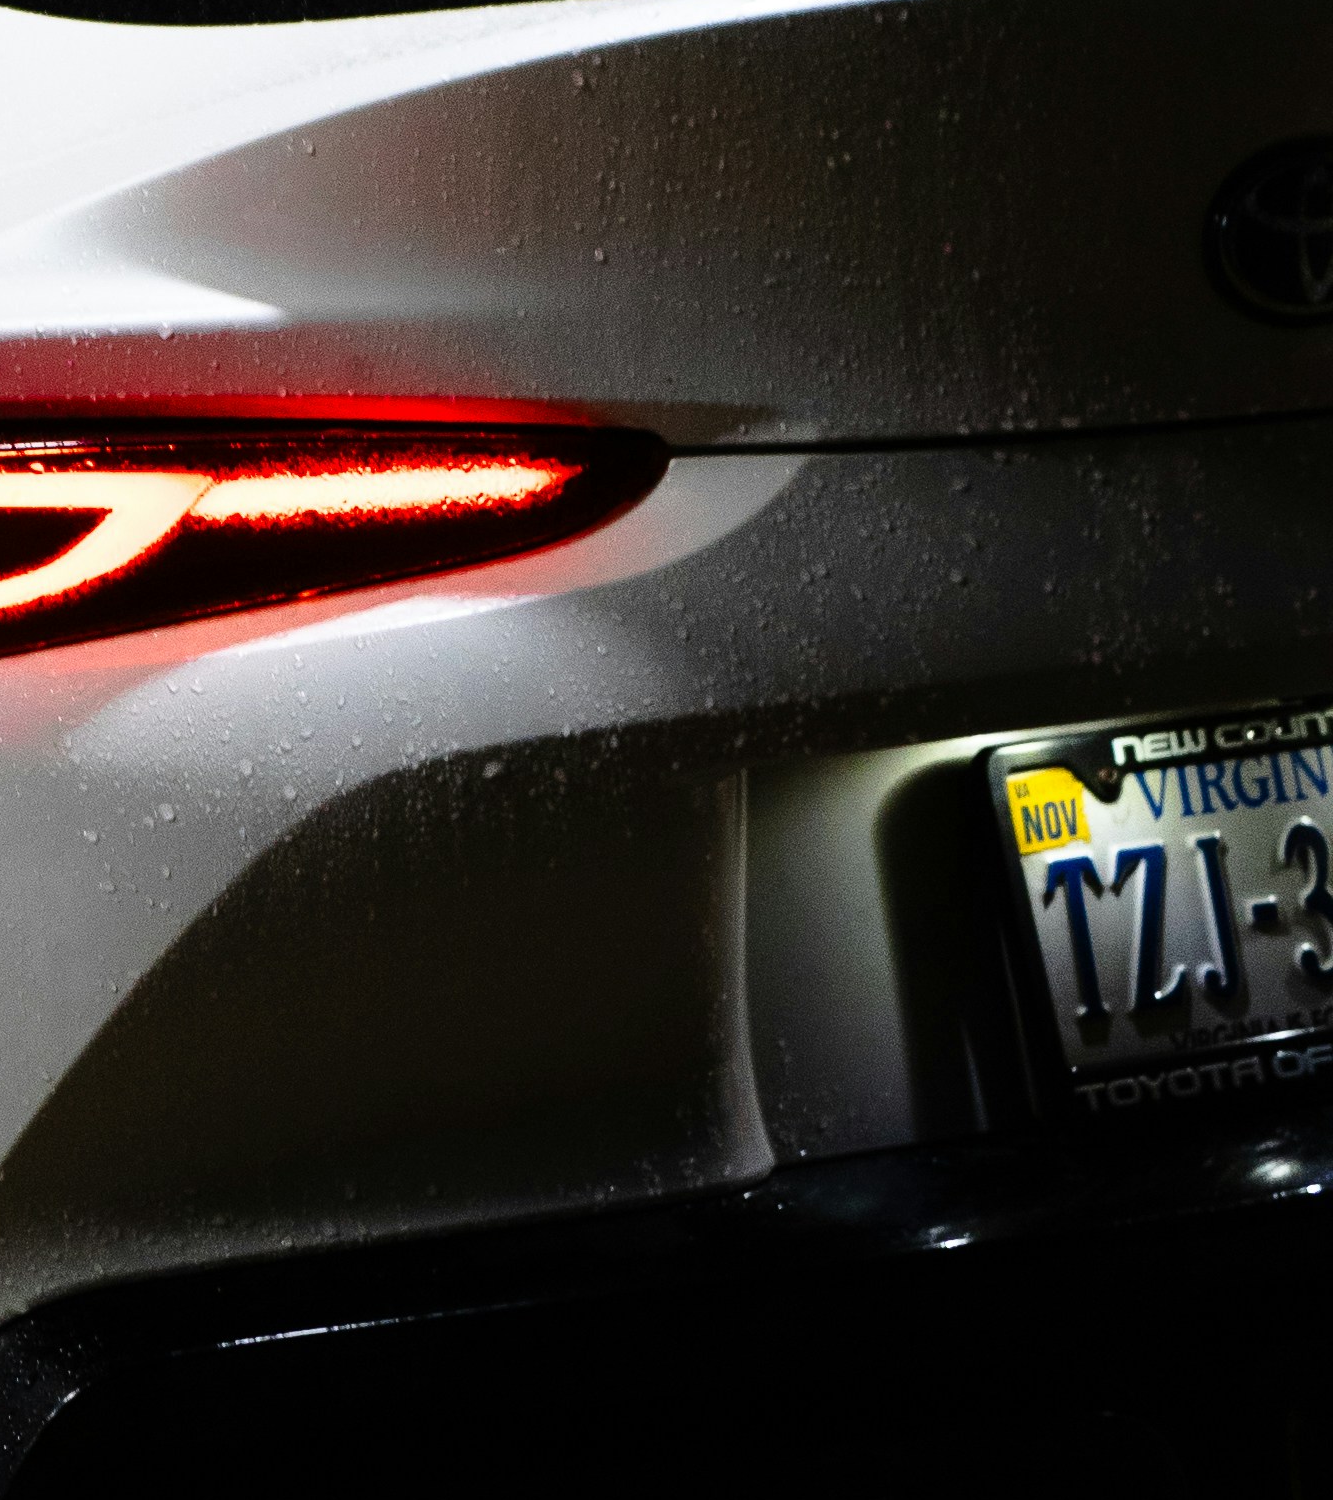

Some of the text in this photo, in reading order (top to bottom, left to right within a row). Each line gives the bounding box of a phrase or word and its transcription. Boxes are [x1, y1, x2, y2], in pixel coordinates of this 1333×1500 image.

[1112, 708, 1333, 767] NEW COUN
[1021, 798, 1078, 844] NOV
[1074, 1054, 1266, 1111] TOYOTA
